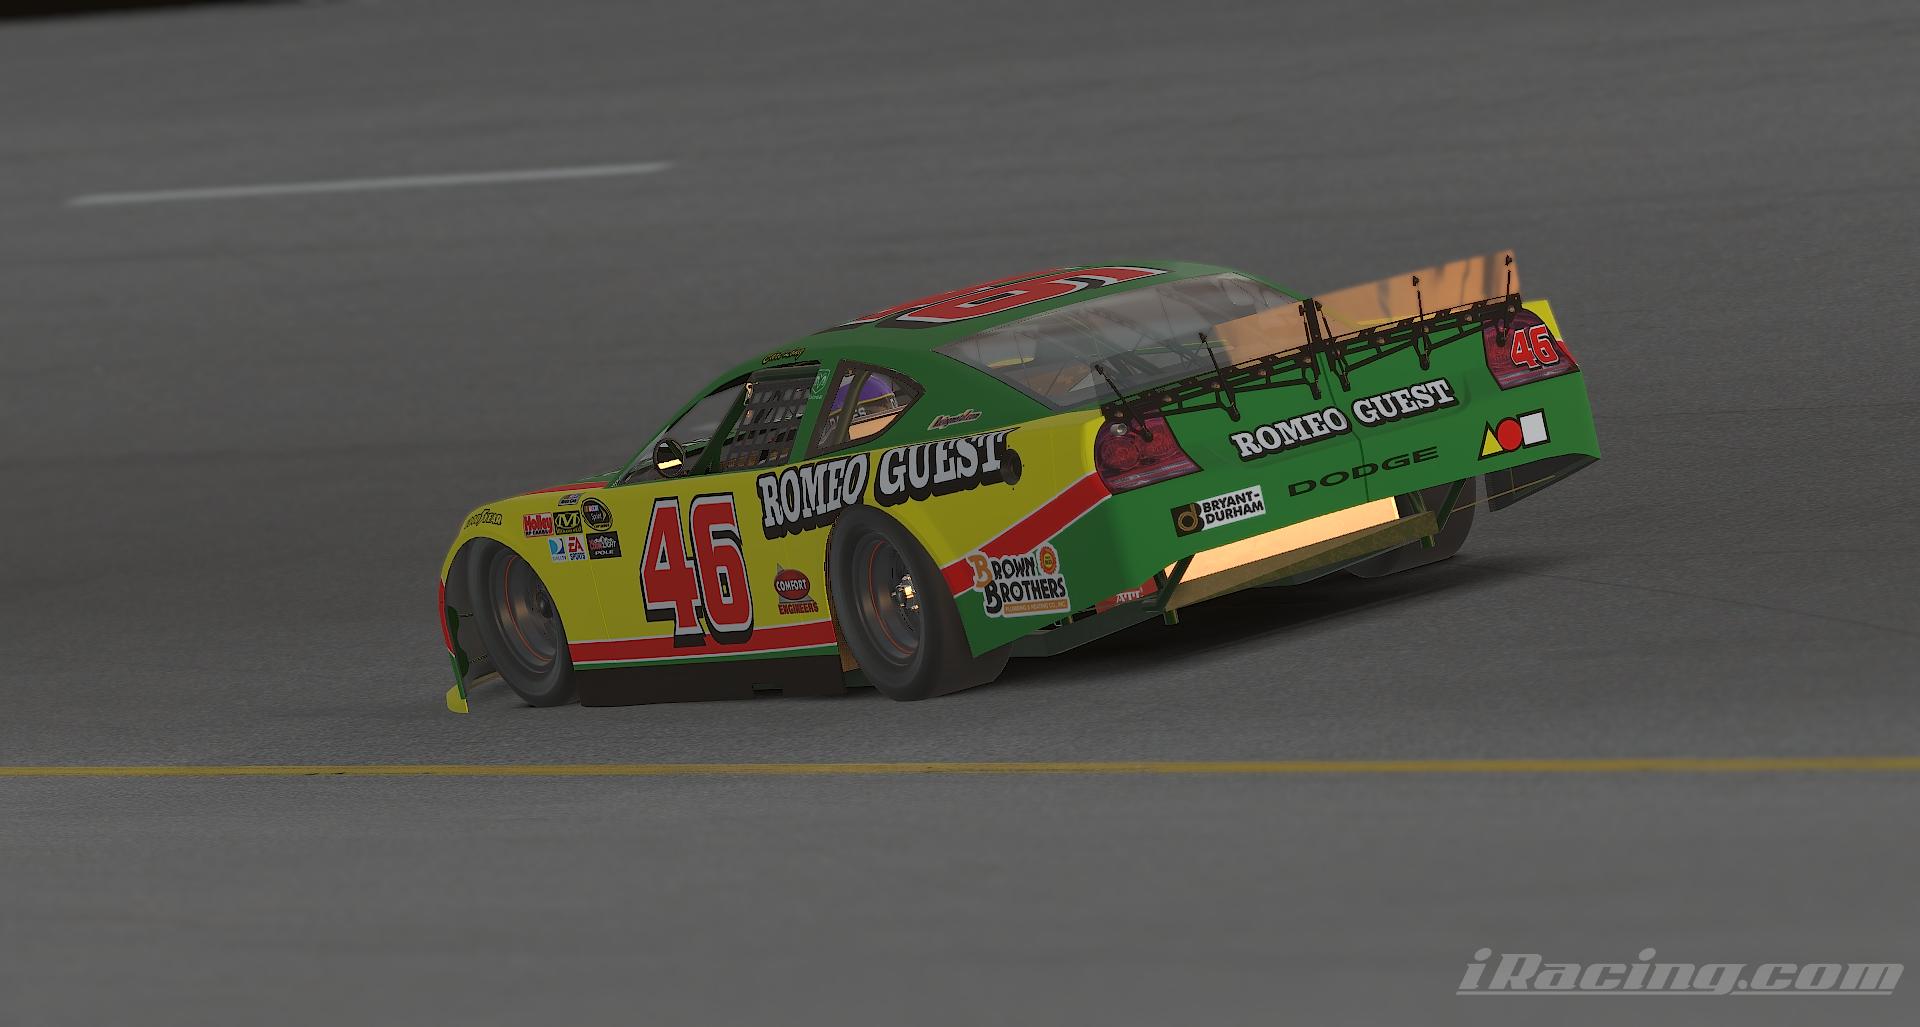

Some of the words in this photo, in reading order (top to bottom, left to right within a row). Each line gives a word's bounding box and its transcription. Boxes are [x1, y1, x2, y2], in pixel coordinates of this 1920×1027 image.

[1510, 323, 1560, 370] 46
[1230, 405, 1351, 461] ROMEO
[1352, 377, 1458, 426] GUEST
[757, 453, 869, 534] ROMEO
[876, 429, 1010, 504] GUEST
[1287, 445, 1440, 497] DODGE
[1202, 490, 1261, 513] BRYANT-
[1205, 500, 1265, 525] DURHAM
[640, 492, 754, 645] 46
[776, 578, 808, 592] COMFORT
[967, 554, 1036, 589] BROWN
[778, 601, 819, 615] ENGINEERS
[984, 577, 1066, 614] BROTHERS
